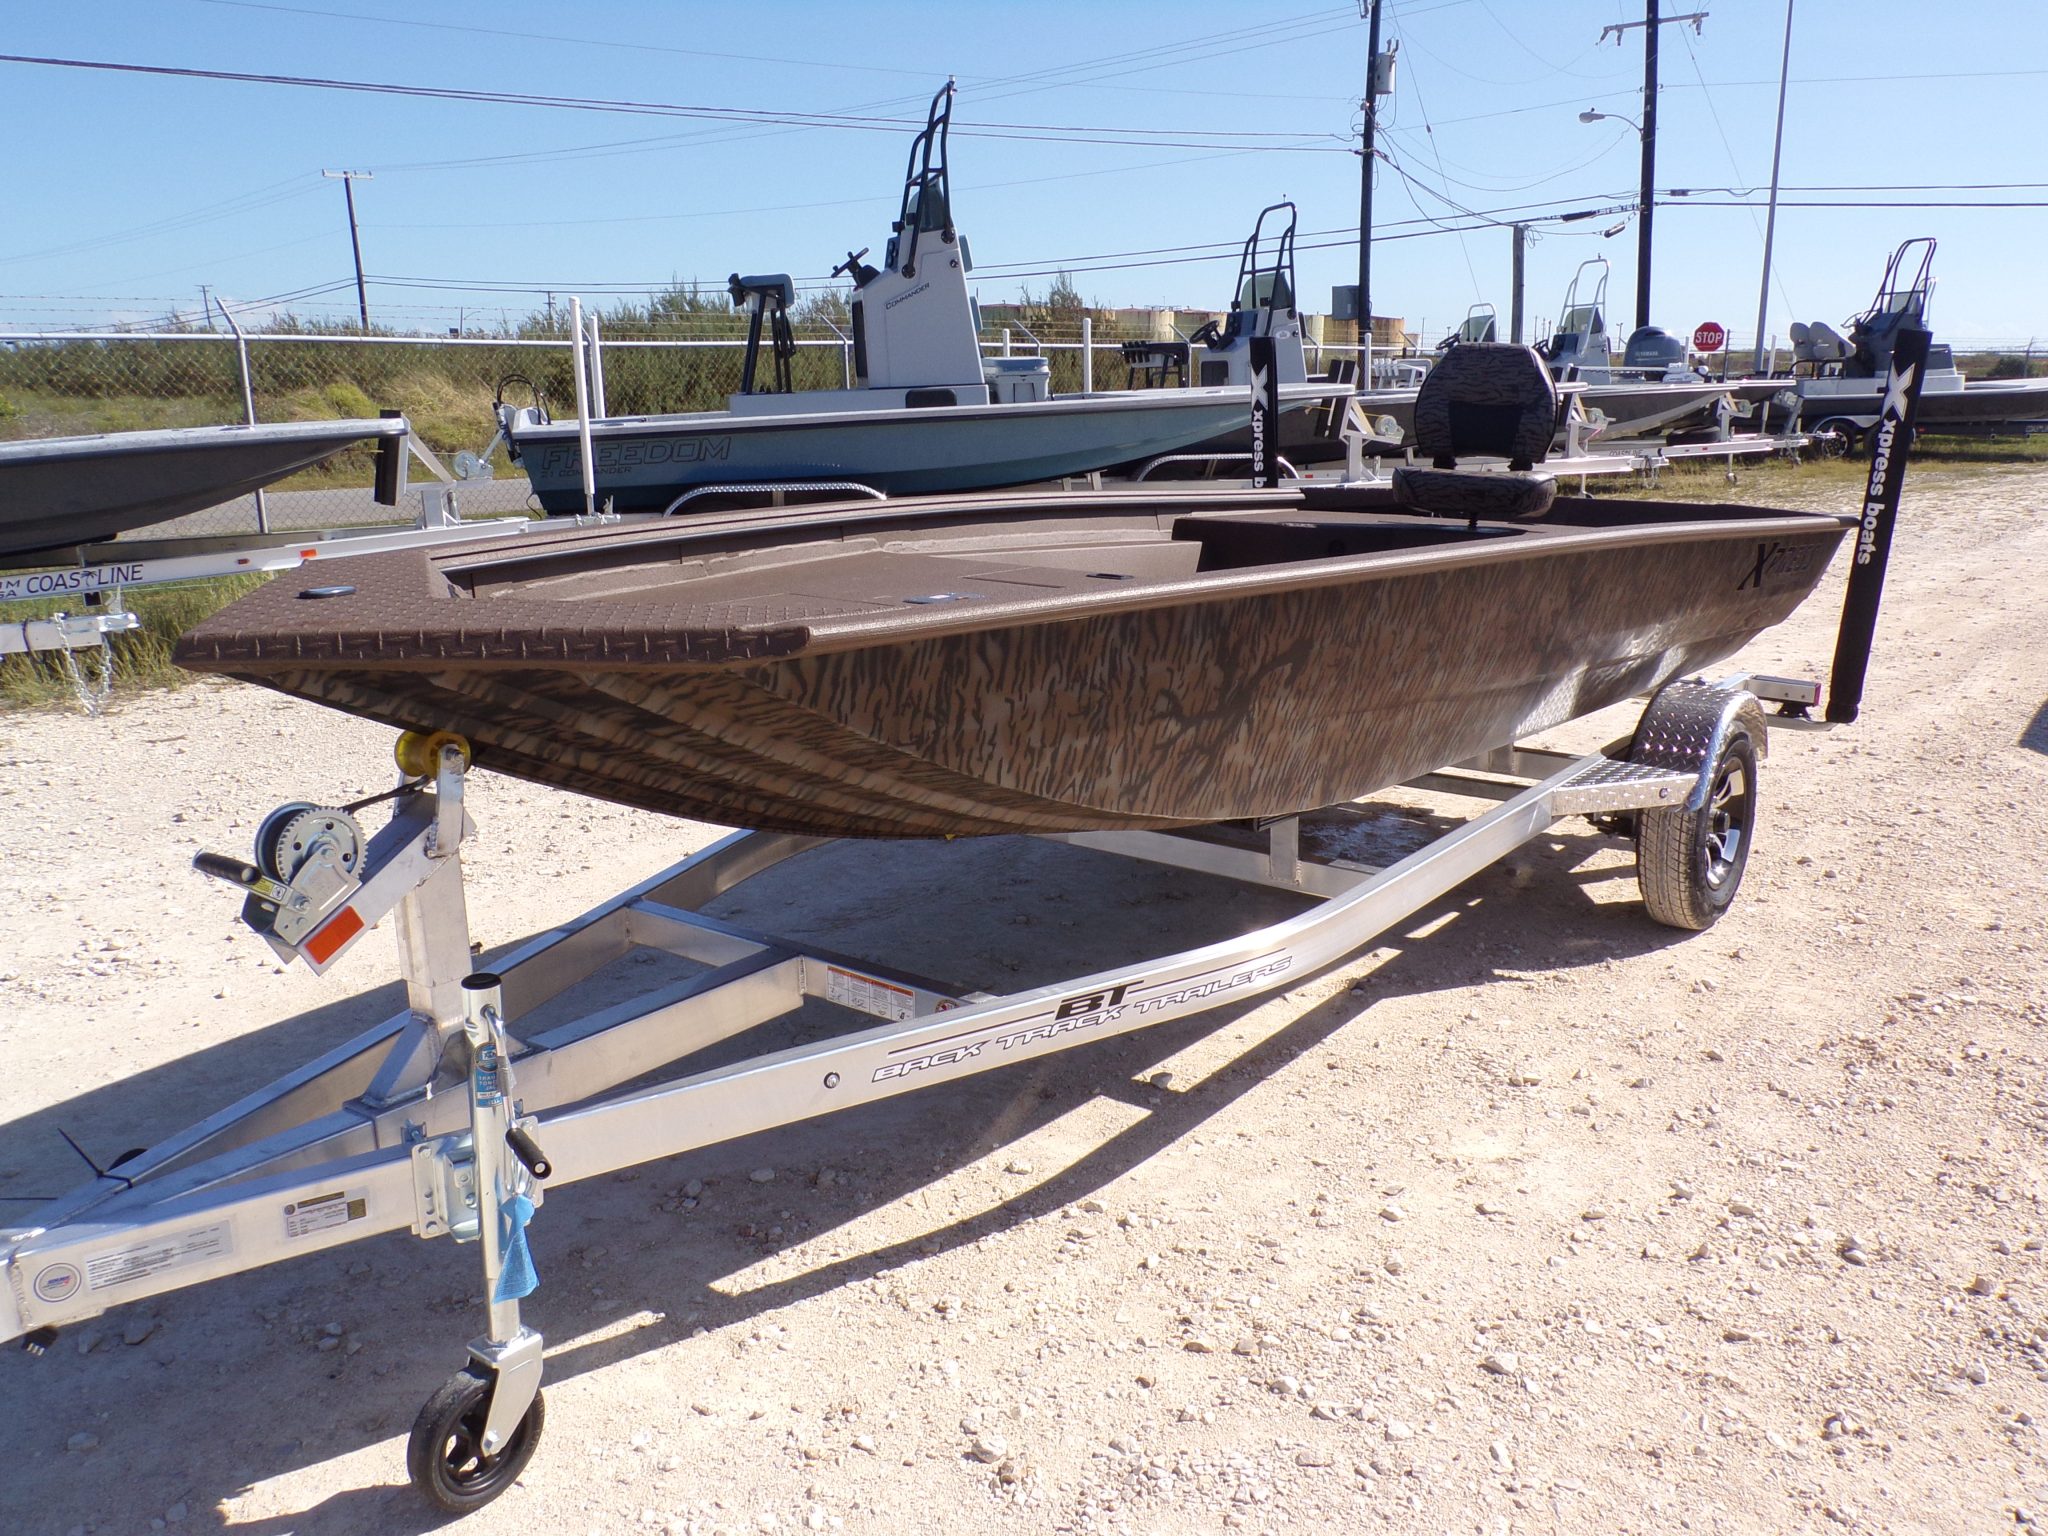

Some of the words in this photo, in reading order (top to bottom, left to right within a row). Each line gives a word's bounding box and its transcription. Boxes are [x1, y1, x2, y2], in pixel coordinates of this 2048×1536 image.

[885, 282, 930, 310] COMMANDER
[1695, 331, 1723, 344] STOP
[542, 436, 732, 470] FREEDOM
[1252, 409, 1264, 472] xpress
[1870, 419, 1897, 496] xpress
[559, 466, 632, 478] COMANDER
[1857, 503, 1885, 565] boats
[872, 1039, 992, 1083] BACK
[996, 1004, 1130, 1050] TRACK
[1133, 956, 1292, 1014] TRAILERS
[1055, 980, 1145, 1021] BT
